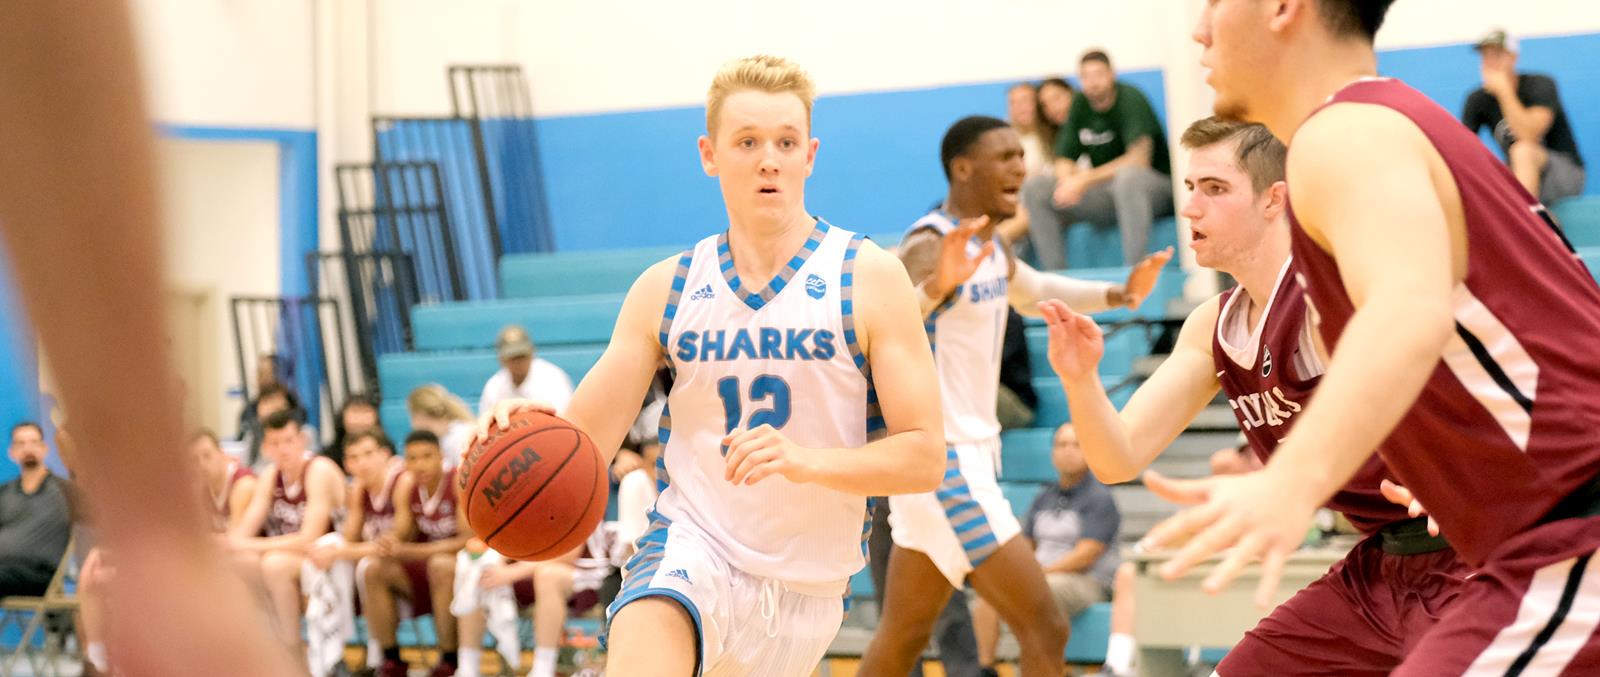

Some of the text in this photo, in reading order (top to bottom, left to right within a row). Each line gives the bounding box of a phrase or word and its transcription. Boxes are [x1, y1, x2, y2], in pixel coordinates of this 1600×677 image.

[676, 327, 836, 362] SHARKS
[717, 374, 792, 457] 12
[482, 447, 542, 507] NCAA
